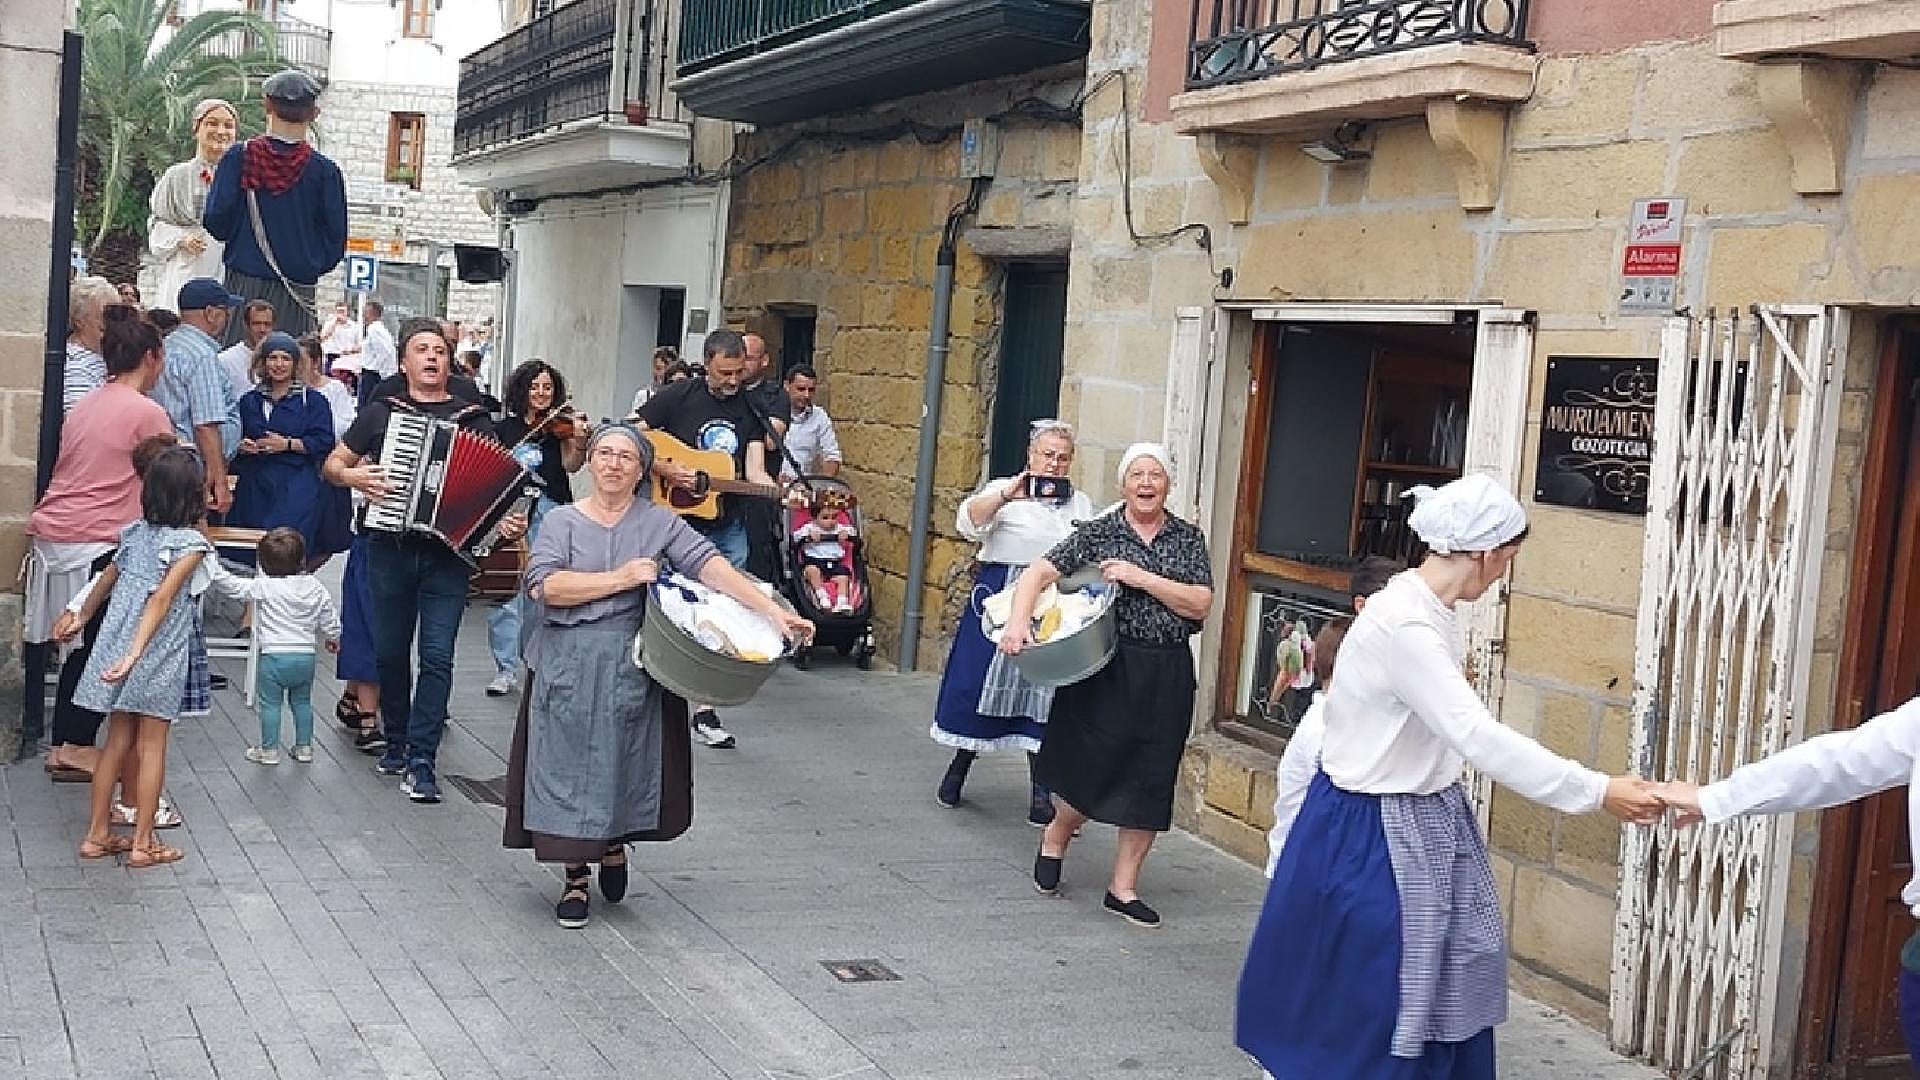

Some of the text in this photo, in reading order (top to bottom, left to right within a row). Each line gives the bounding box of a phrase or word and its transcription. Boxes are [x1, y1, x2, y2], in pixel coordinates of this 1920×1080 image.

[1627, 248, 1677, 264] Alarma
[350, 260, 370, 286] P
[1546, 405, 1654, 438] MURUAMEN
